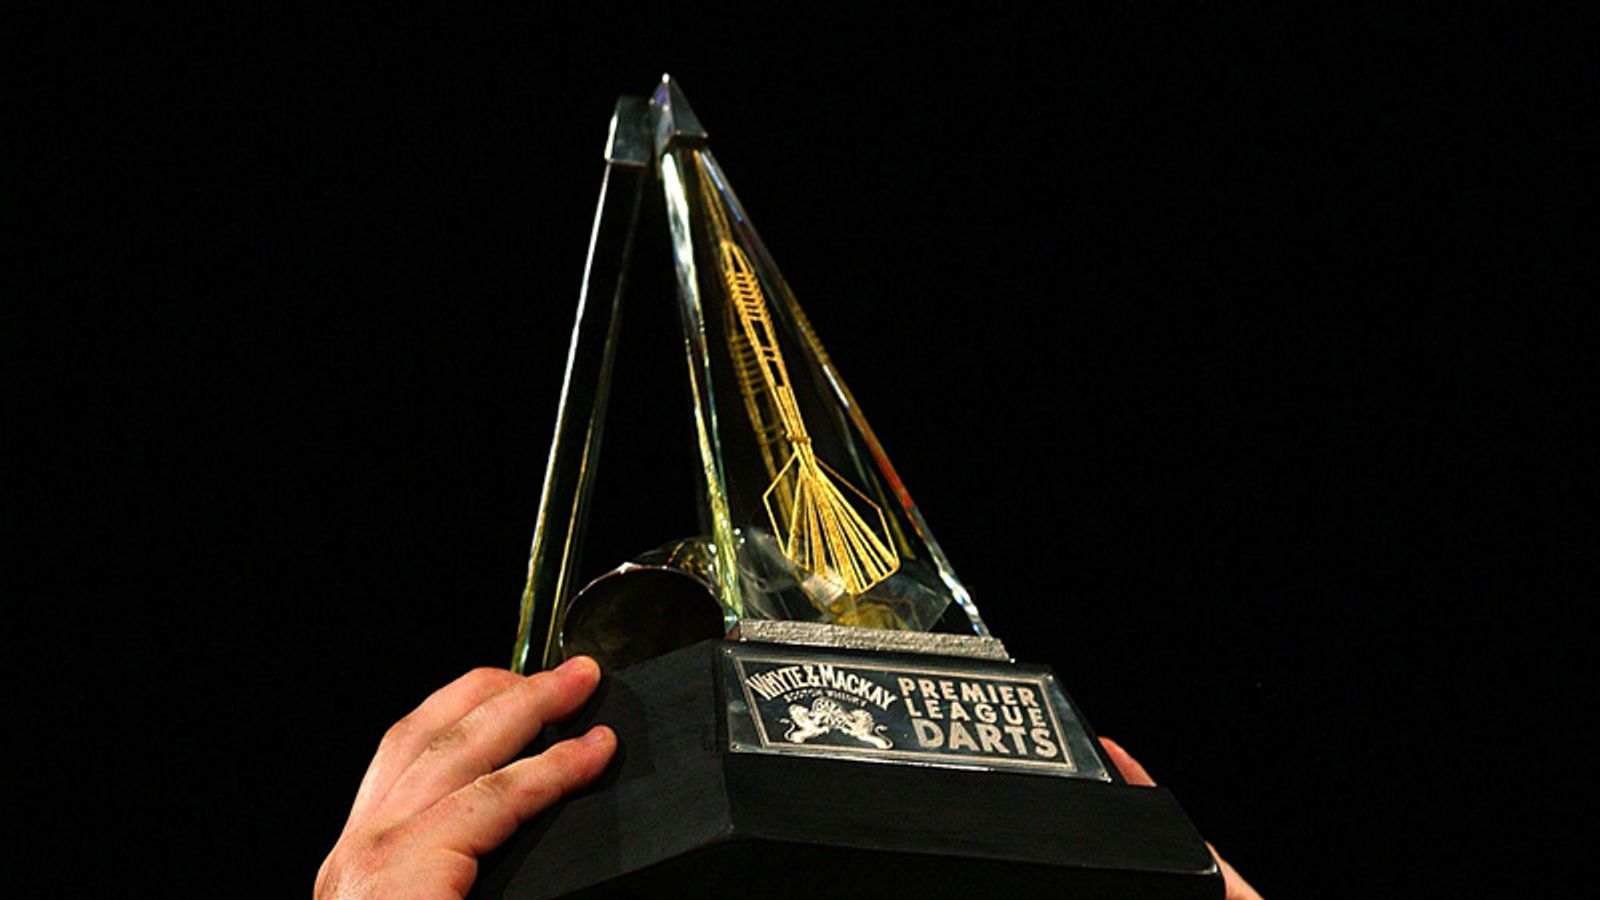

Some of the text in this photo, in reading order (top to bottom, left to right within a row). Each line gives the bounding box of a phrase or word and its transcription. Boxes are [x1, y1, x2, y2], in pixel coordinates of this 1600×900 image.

[898, 677, 1039, 707] PREMIER
[904, 698, 1047, 728] LEAGUE
[911, 718, 1058, 758] DARTS
